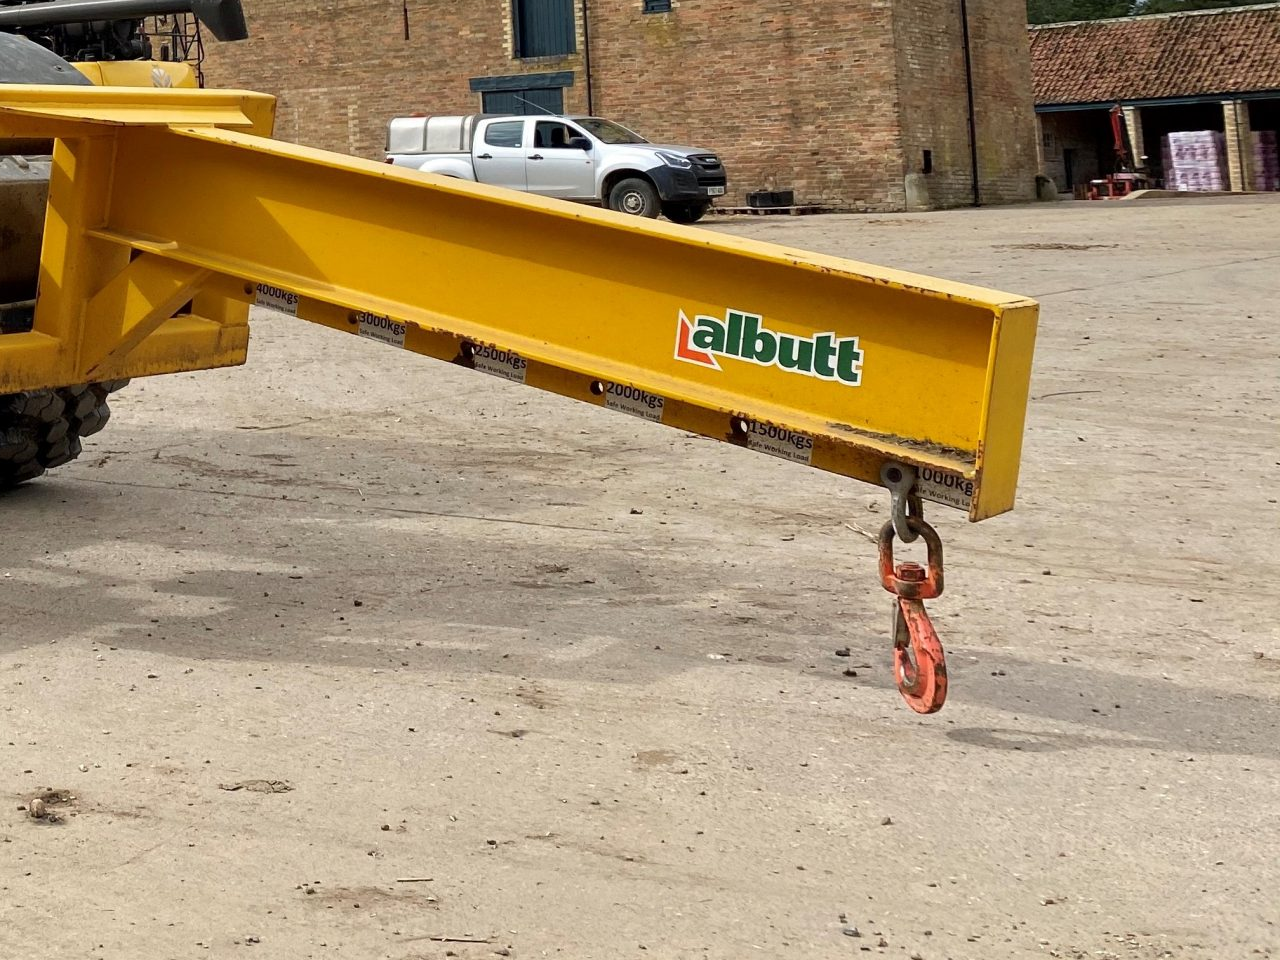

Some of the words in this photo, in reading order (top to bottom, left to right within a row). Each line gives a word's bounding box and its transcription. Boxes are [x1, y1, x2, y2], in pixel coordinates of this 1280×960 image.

[256, 283, 299, 305] 4000kgs
[359, 312, 406, 336] 3000kgs
[475, 345, 527, 370] 2500kgs
[692, 311, 861, 383] albutt
[487, 366, 511, 378] Working
[606, 381, 664, 409] 2000kgs
[620, 404, 645, 417] Working
[645, 411, 661, 421] Load
[750, 420, 813, 450] 1500kgs
[764, 444, 792, 458] Working
[793, 452, 810, 462] Load
[929, 491, 961, 506] Working
